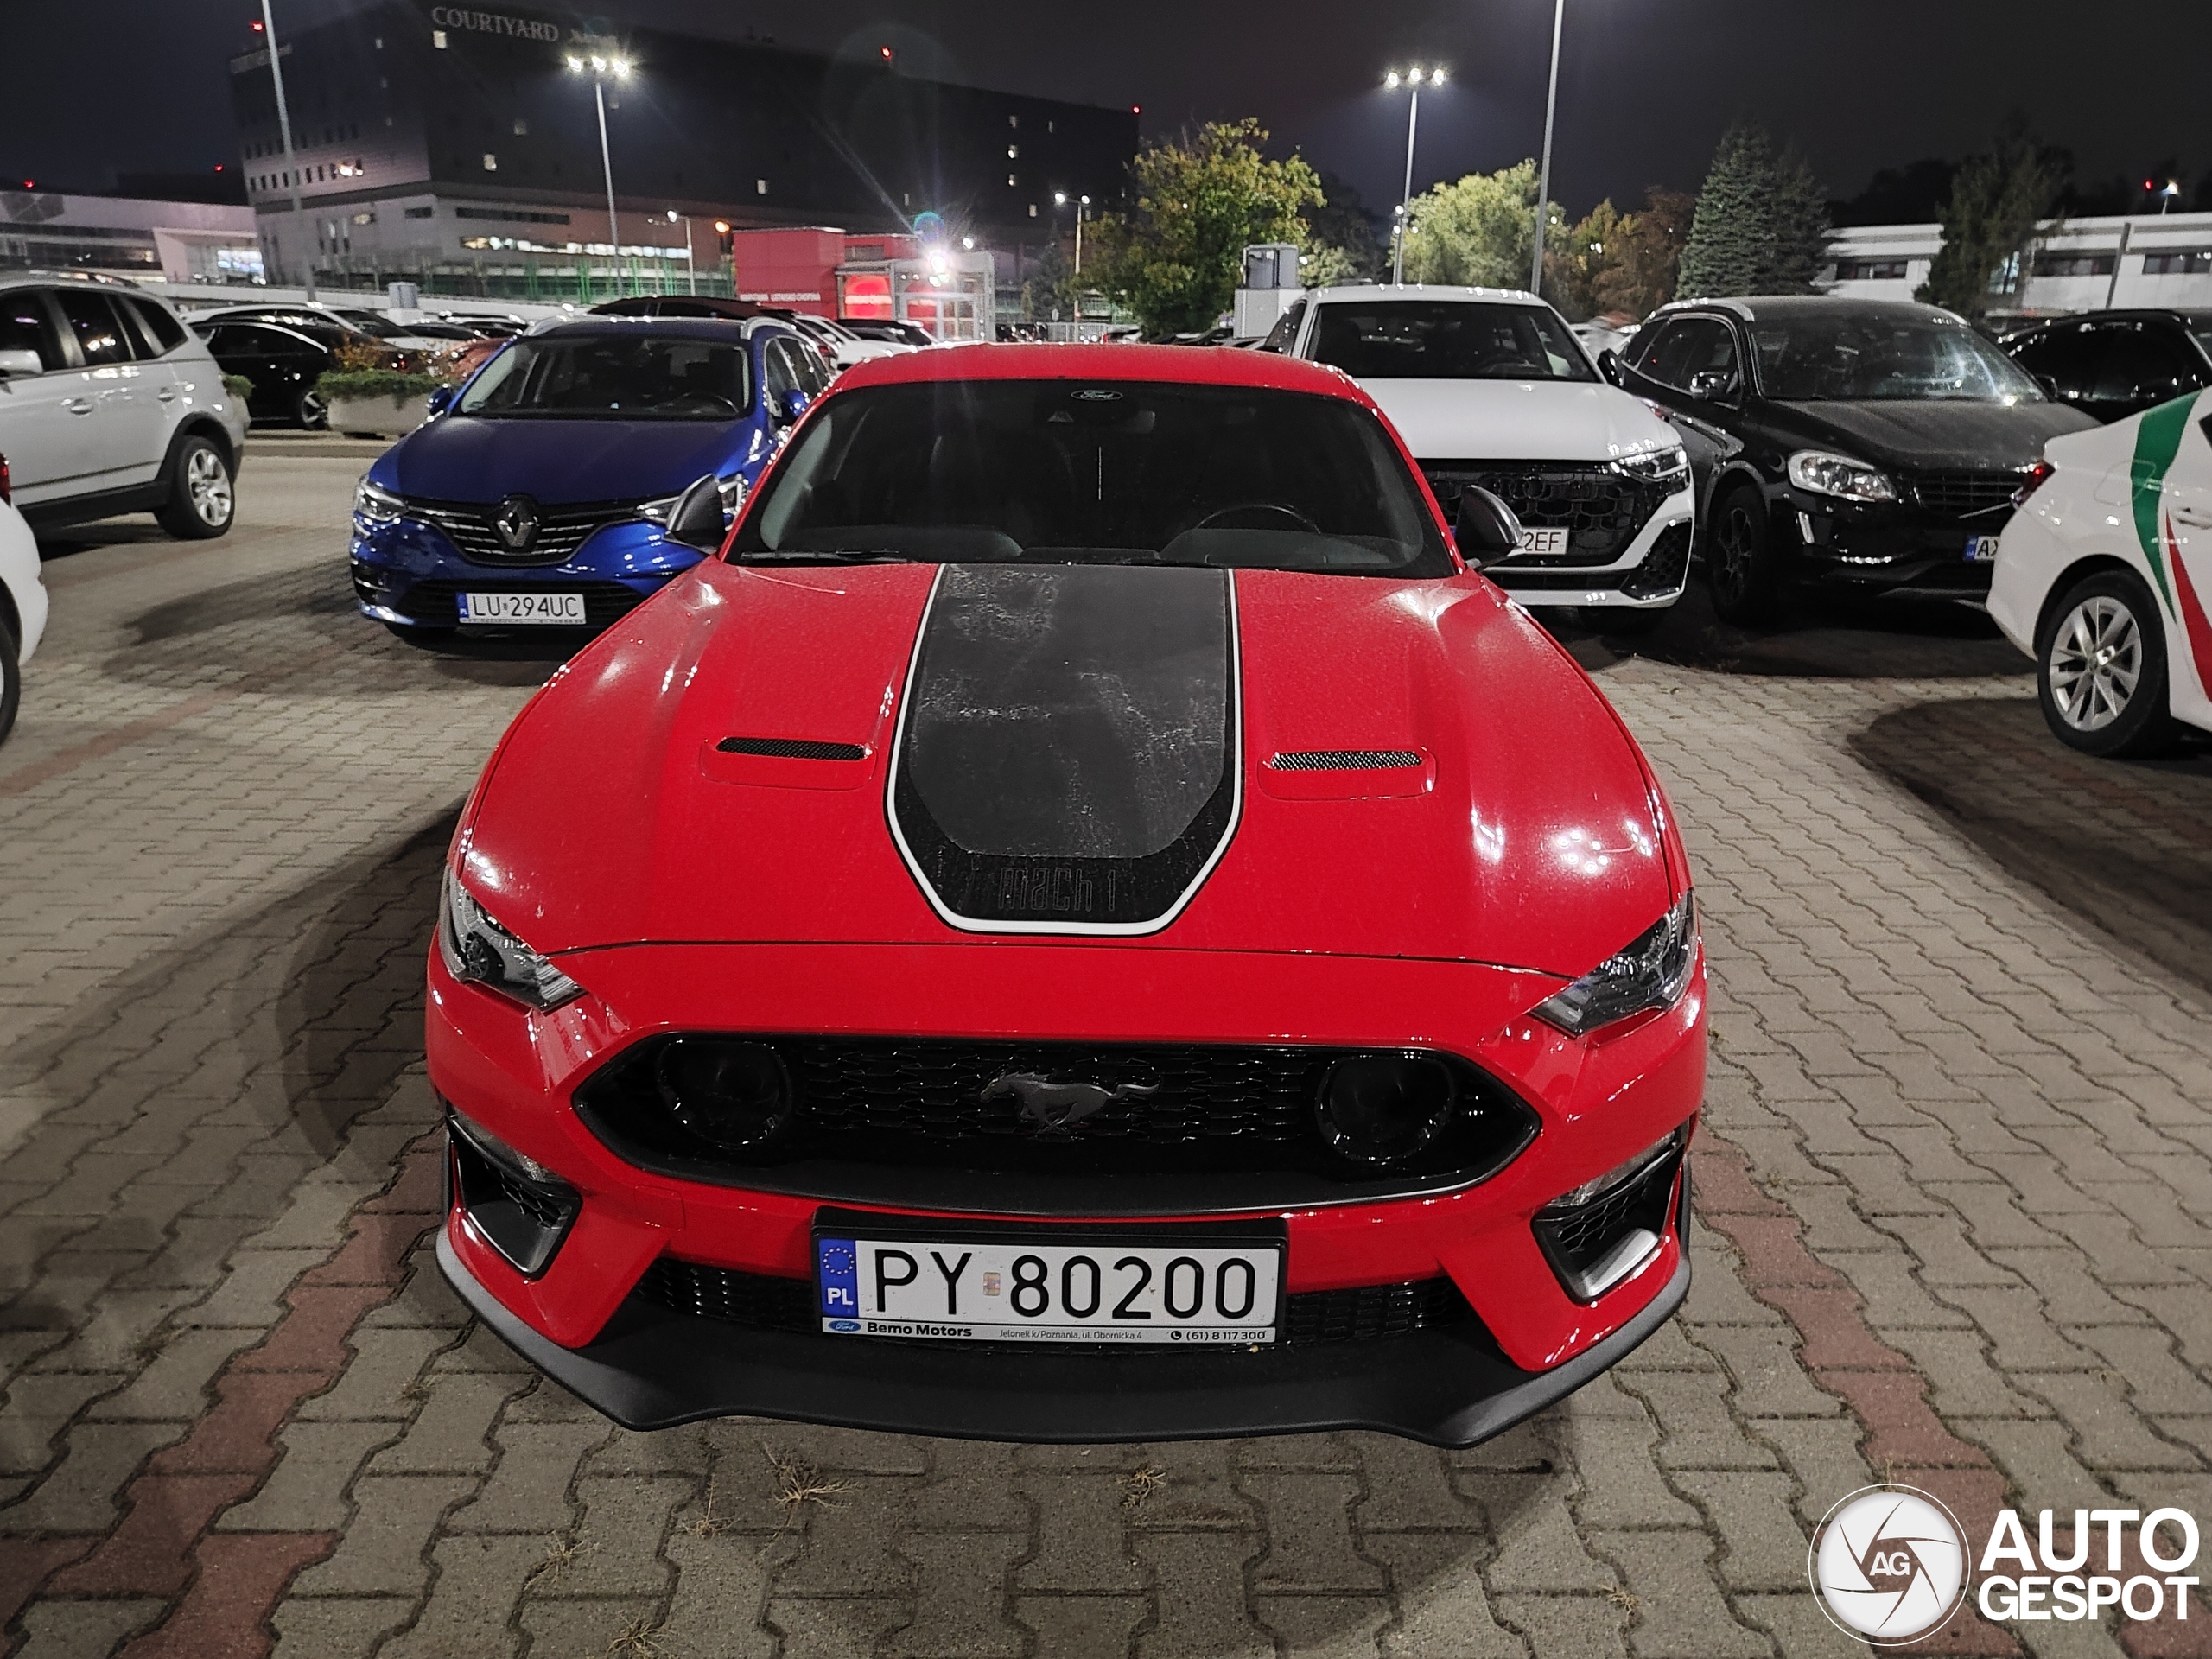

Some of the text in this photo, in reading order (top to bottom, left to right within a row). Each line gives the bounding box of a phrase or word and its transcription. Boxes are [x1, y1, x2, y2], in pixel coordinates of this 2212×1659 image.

[432, 6, 559, 42] COURTYARD
[473, 596, 579, 617] LU 294UC
[874, 1249, 1255, 1320] PY 80200
[827, 1287, 854, 1306] PL
[833, 1322, 856, 1332] Ford
[868, 1322, 972, 1337] Bemo Motors
[999, 1329, 1030, 1338] Jelonek
[1093, 1331, 1135, 1340] Obornicka
[1185, 1331, 1266, 1341] (61) 8 117 300
